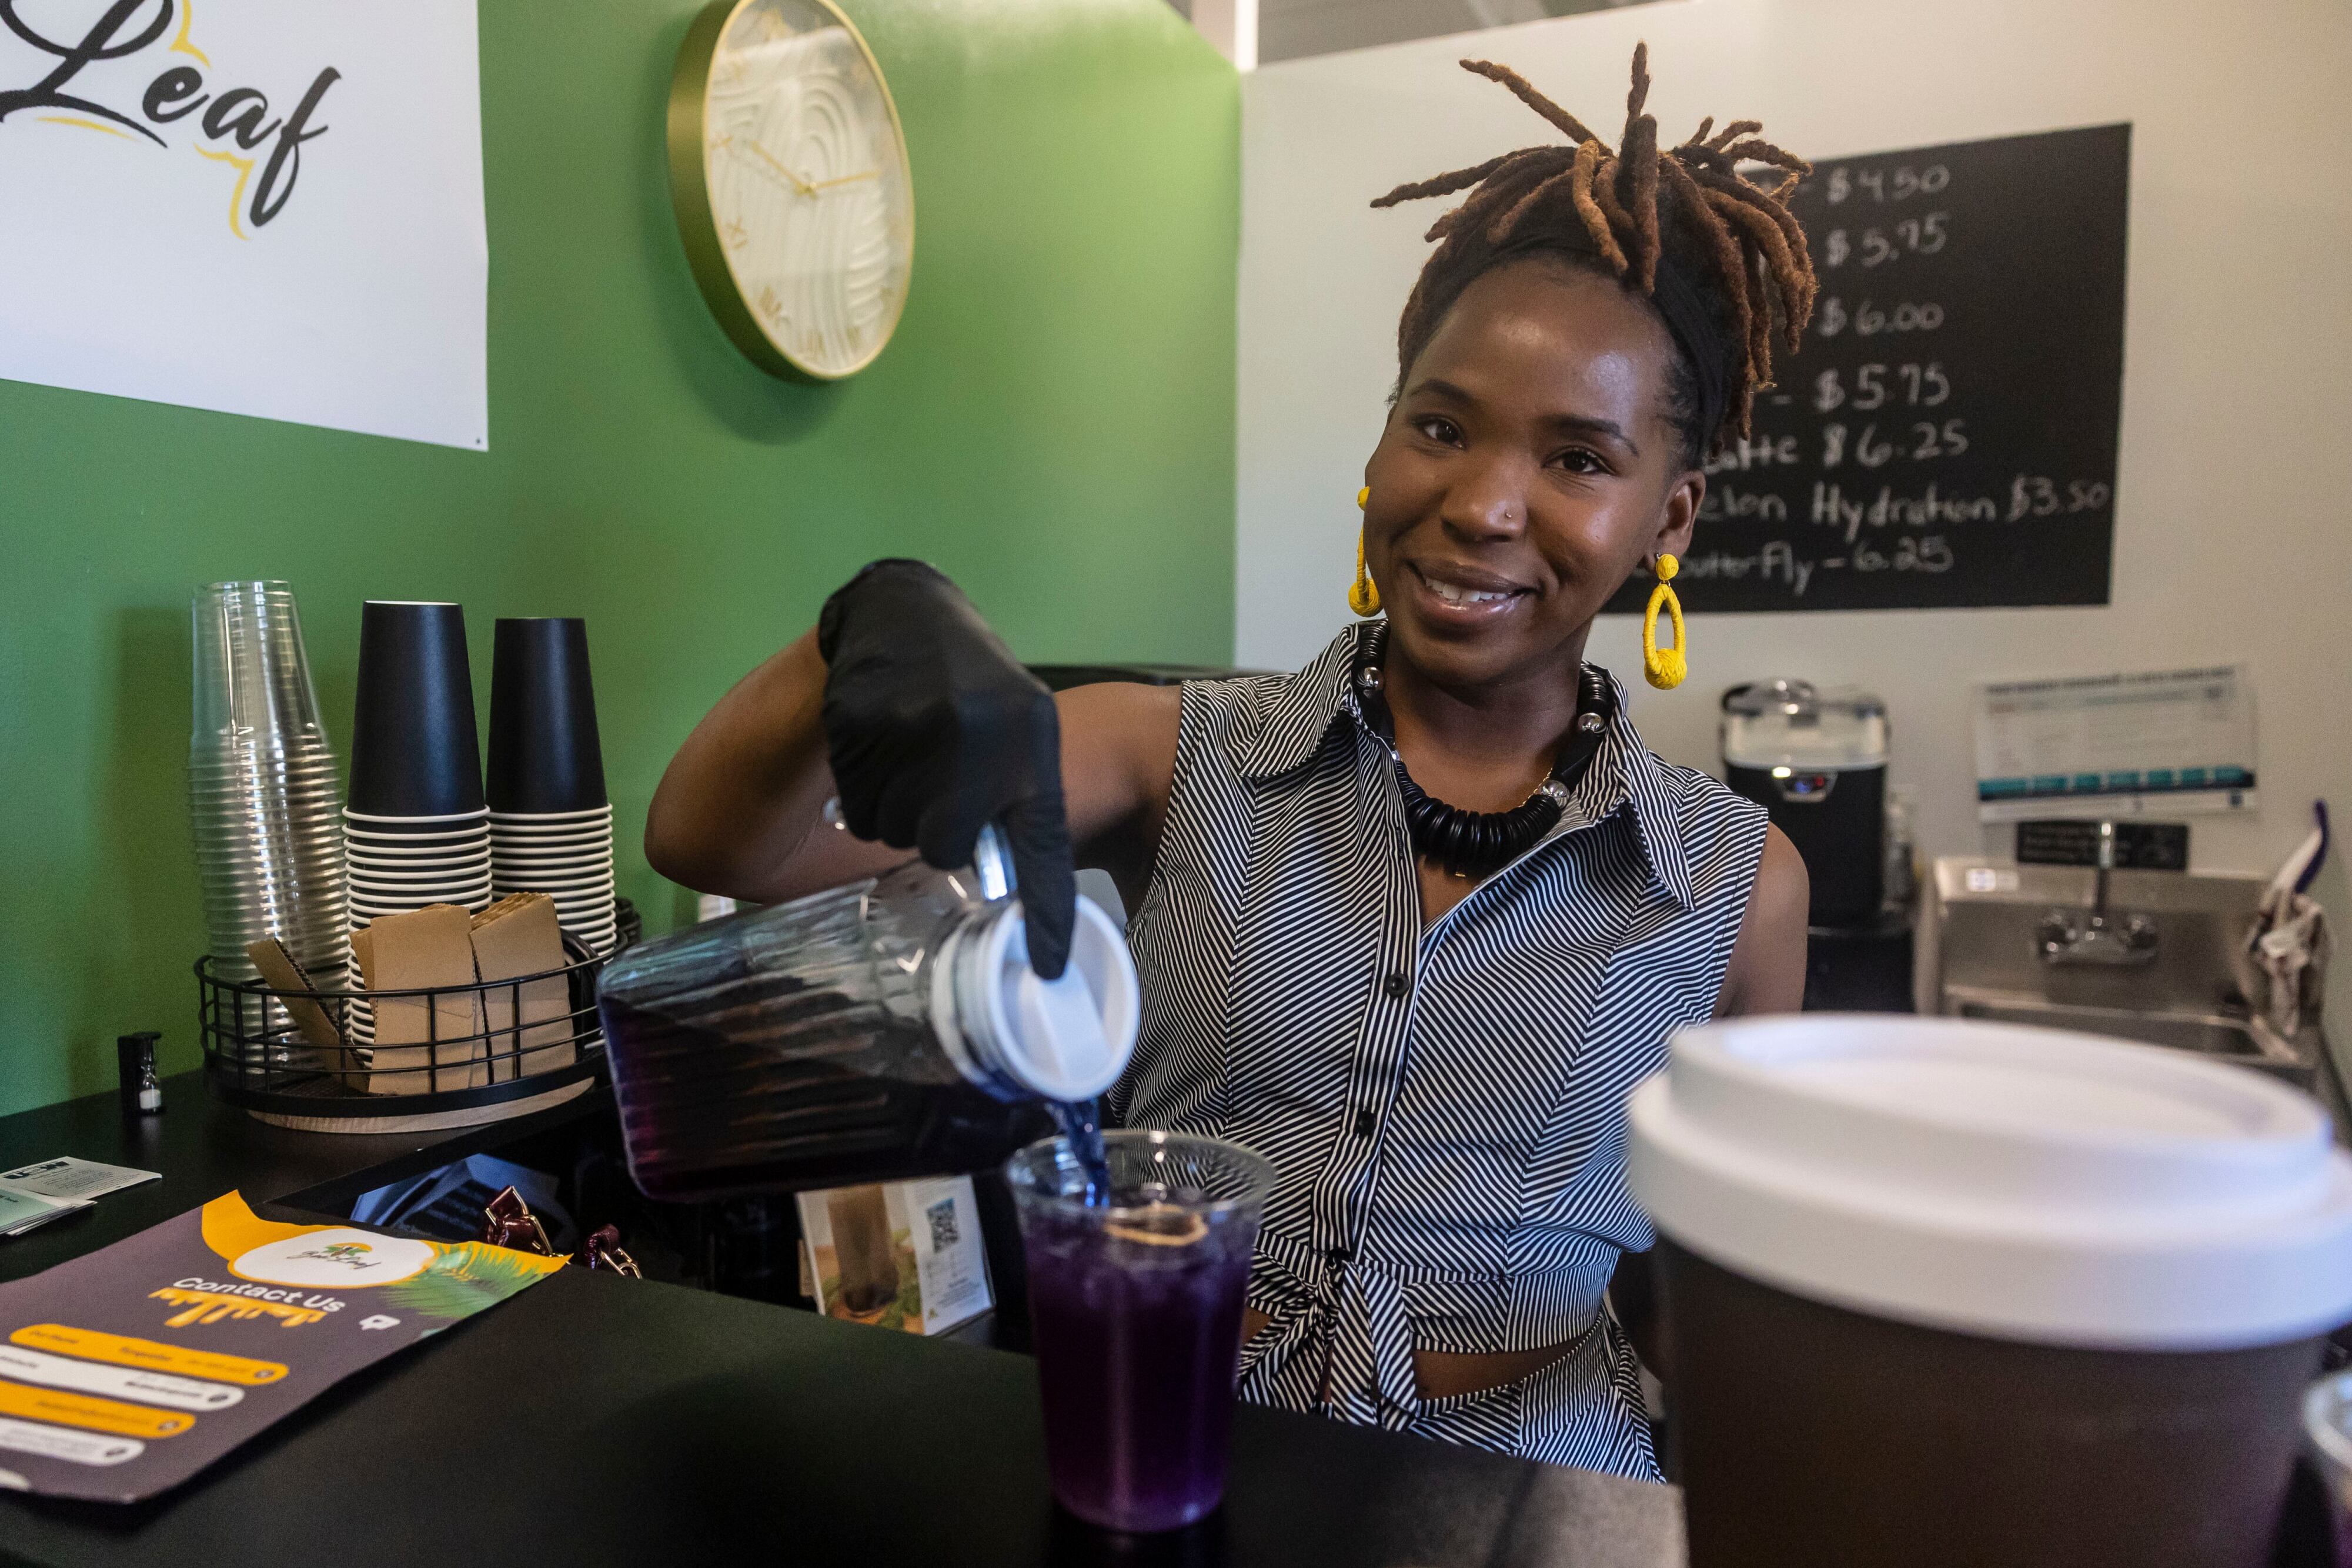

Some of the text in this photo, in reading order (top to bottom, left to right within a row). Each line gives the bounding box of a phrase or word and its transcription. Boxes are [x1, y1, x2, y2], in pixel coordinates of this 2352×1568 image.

[0, 0, 342, 228] Leaf
[172, 1277, 346, 1312] Contact Us
